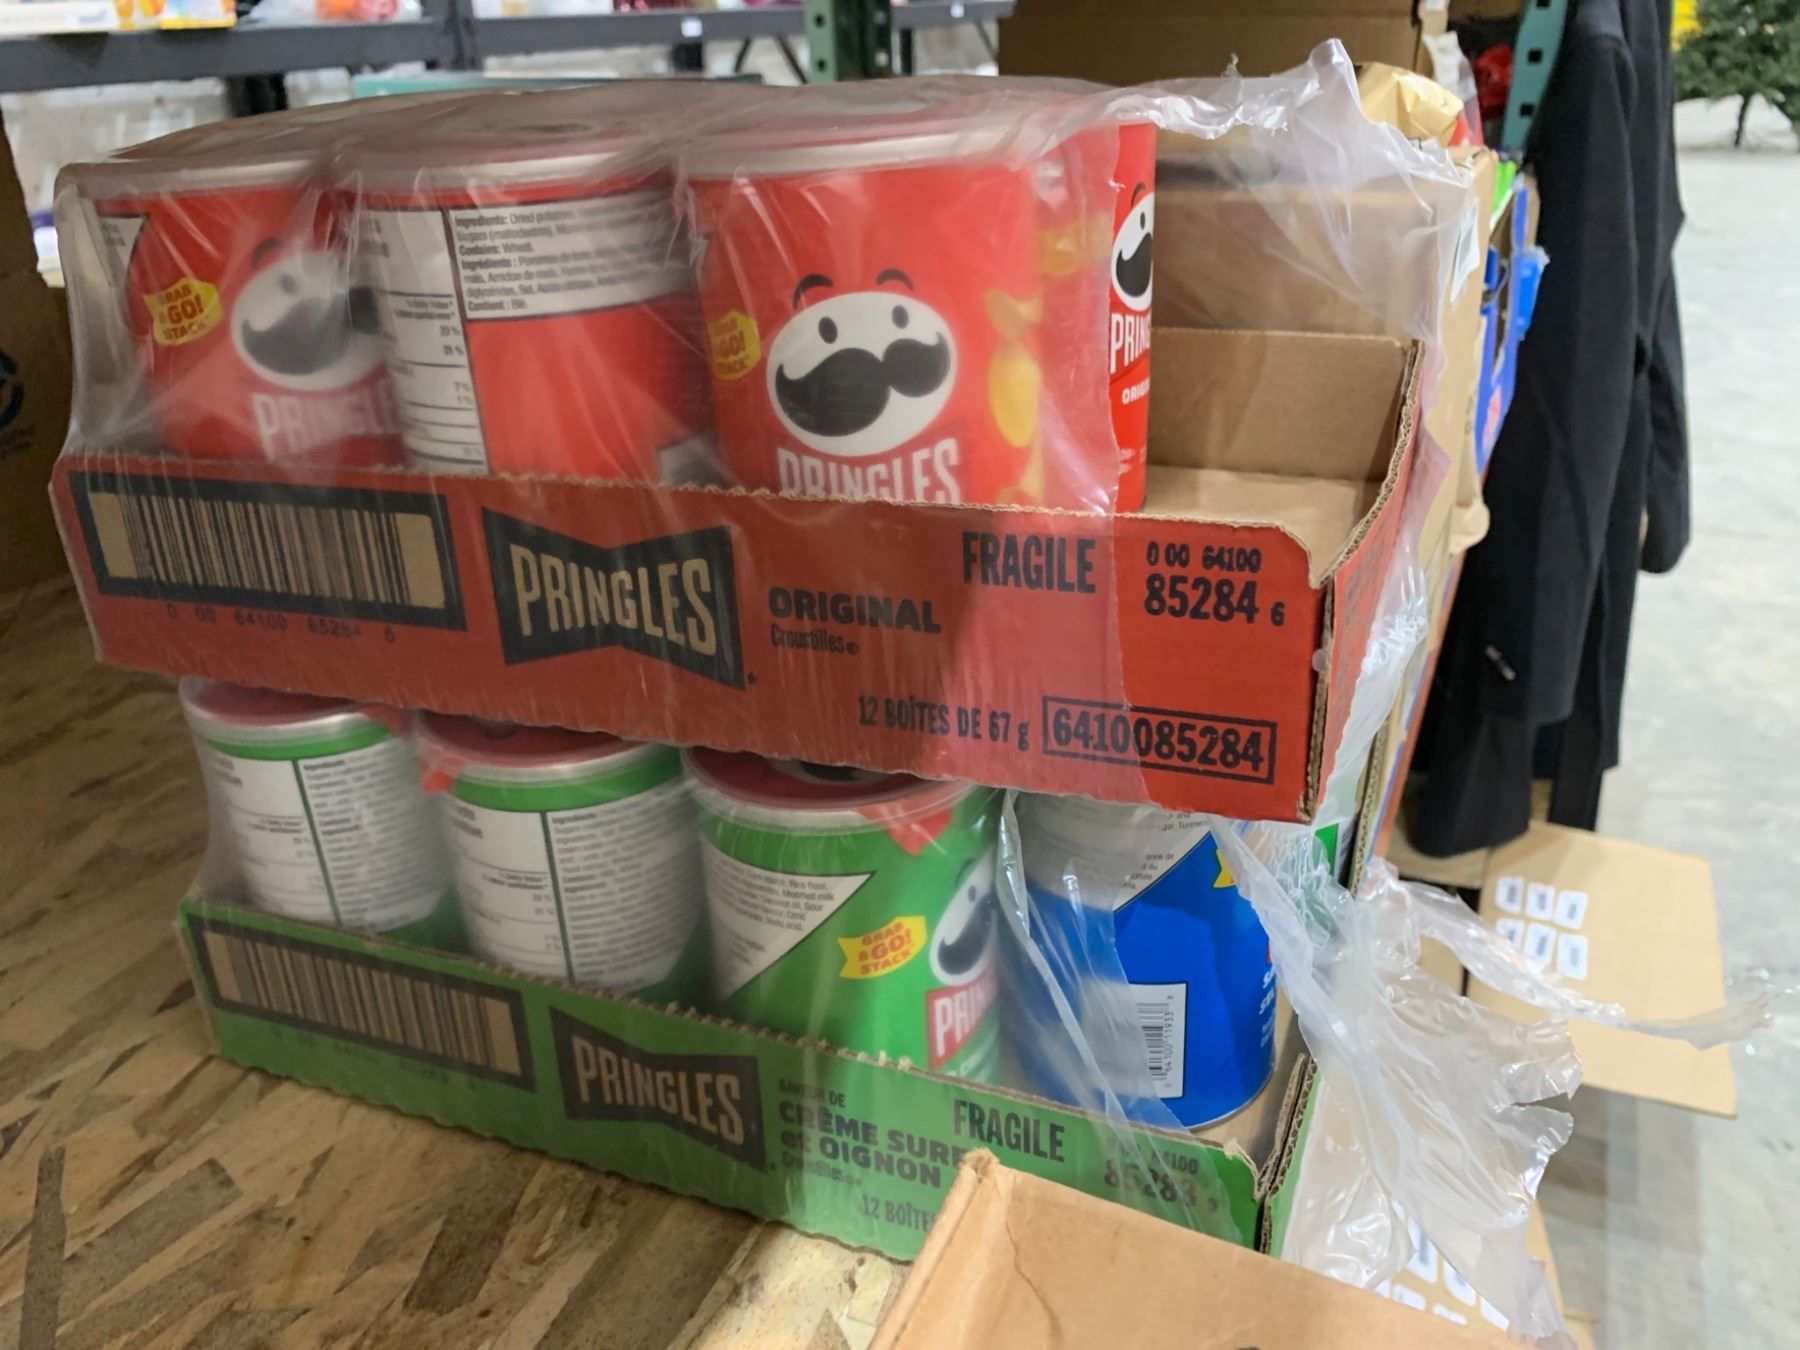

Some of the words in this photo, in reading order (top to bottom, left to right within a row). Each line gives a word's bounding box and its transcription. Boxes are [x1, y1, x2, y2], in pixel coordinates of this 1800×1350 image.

[168, 294, 204, 325] GO!
[1110, 312, 1151, 375] PRIN
[962, 531, 1096, 593] FRAGILE
[1147, 541, 1159, 566] 0
[1165, 543, 1190, 568] 00
[1202, 545, 1262, 574] 64100
[509, 543, 717, 656] PRINGLES
[768, 586, 941, 634] ORIGINAL
[1144, 573, 1259, 624] 85284
[1271, 601, 1285, 627] 6
[858, 695, 878, 726] 12
[957, 706, 982, 739] DE
[988, 710, 1012, 743] 67
[1017, 721, 1029, 752] g
[1052, 707, 1265, 772] 6410085284
[862, 922, 904, 946] GRAB
[871, 928, 912, 959] GO!
[860, 949, 912, 975] STACK
[571, 1035, 745, 1146] PRINGLES
[954, 1100, 1065, 1163] FRAGILE
[819, 1136, 941, 1188] OIGNON
